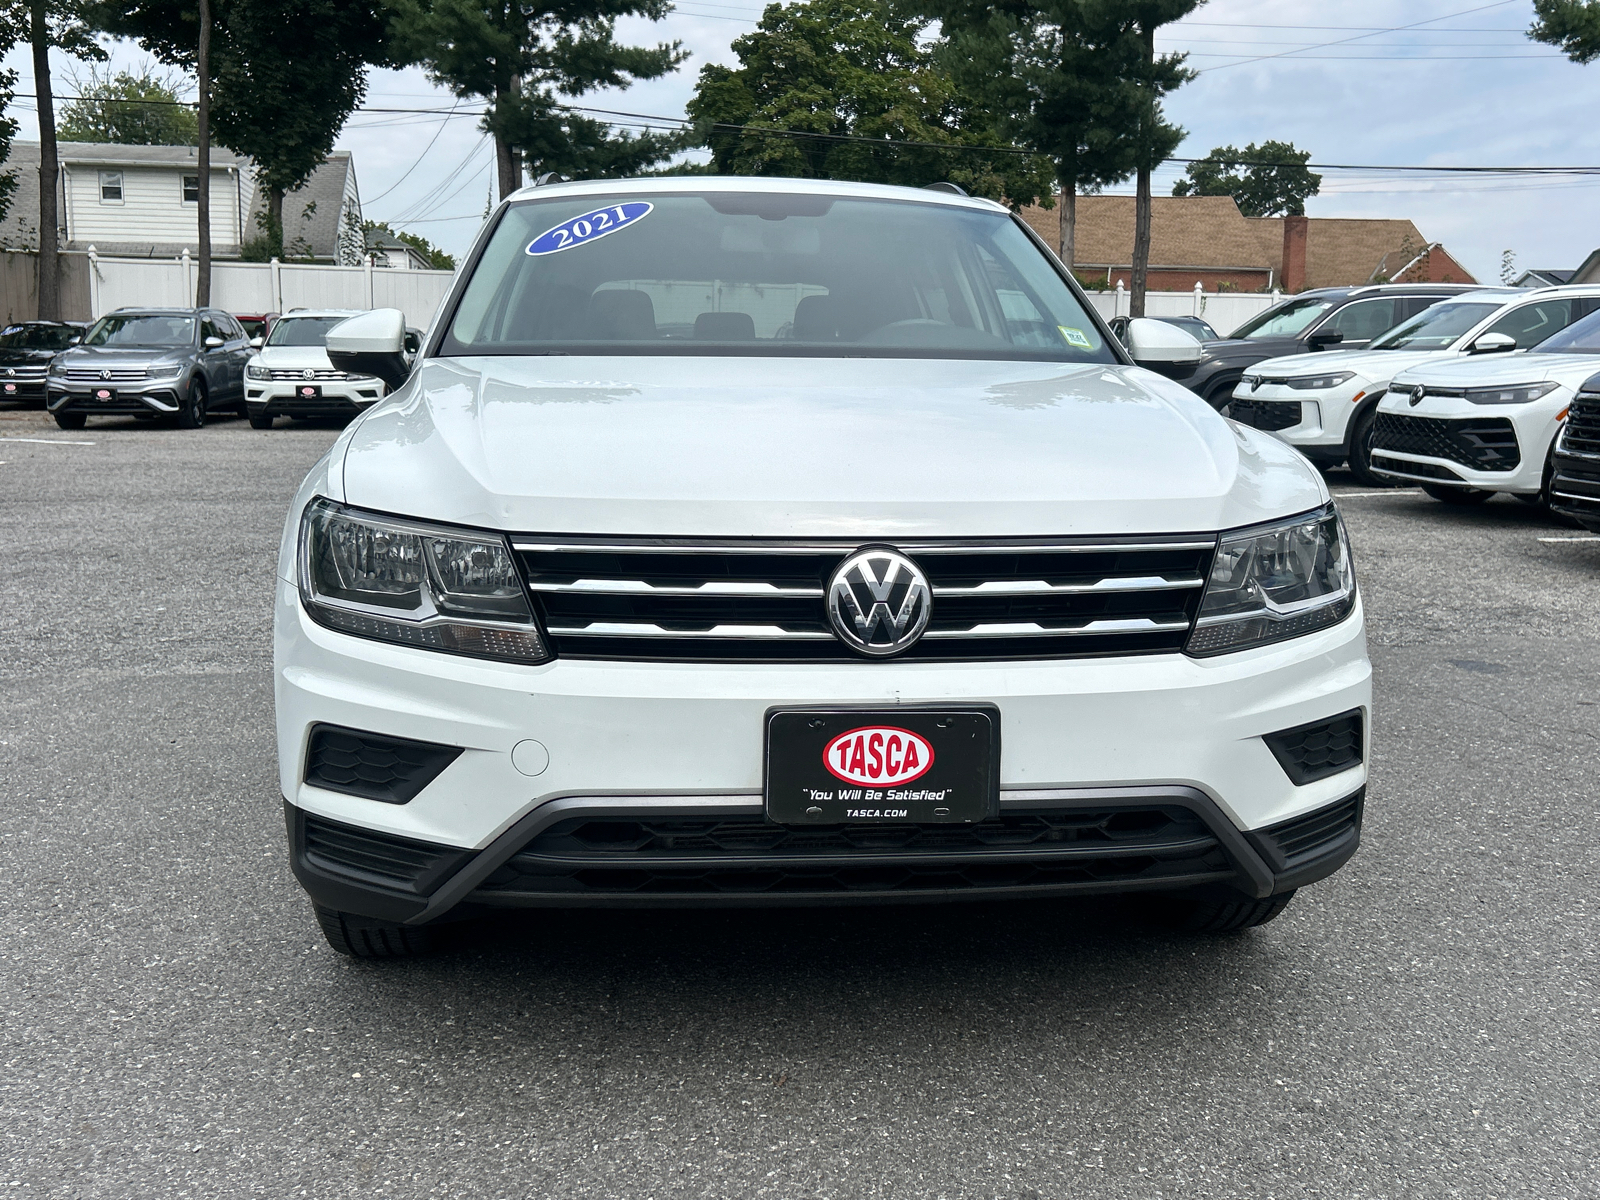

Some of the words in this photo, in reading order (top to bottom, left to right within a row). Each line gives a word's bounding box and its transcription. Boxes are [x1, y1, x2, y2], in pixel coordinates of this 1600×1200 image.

[552, 205, 631, 249] 2021
[836, 732, 920, 779] TASCA
[802, 788, 833, 801] "You
[838, 789, 862, 801] Will
[864, 789, 883, 801] Be
[886, 788, 953, 801] Satisfied"
[846, 809, 908, 818] TASCA.COM
